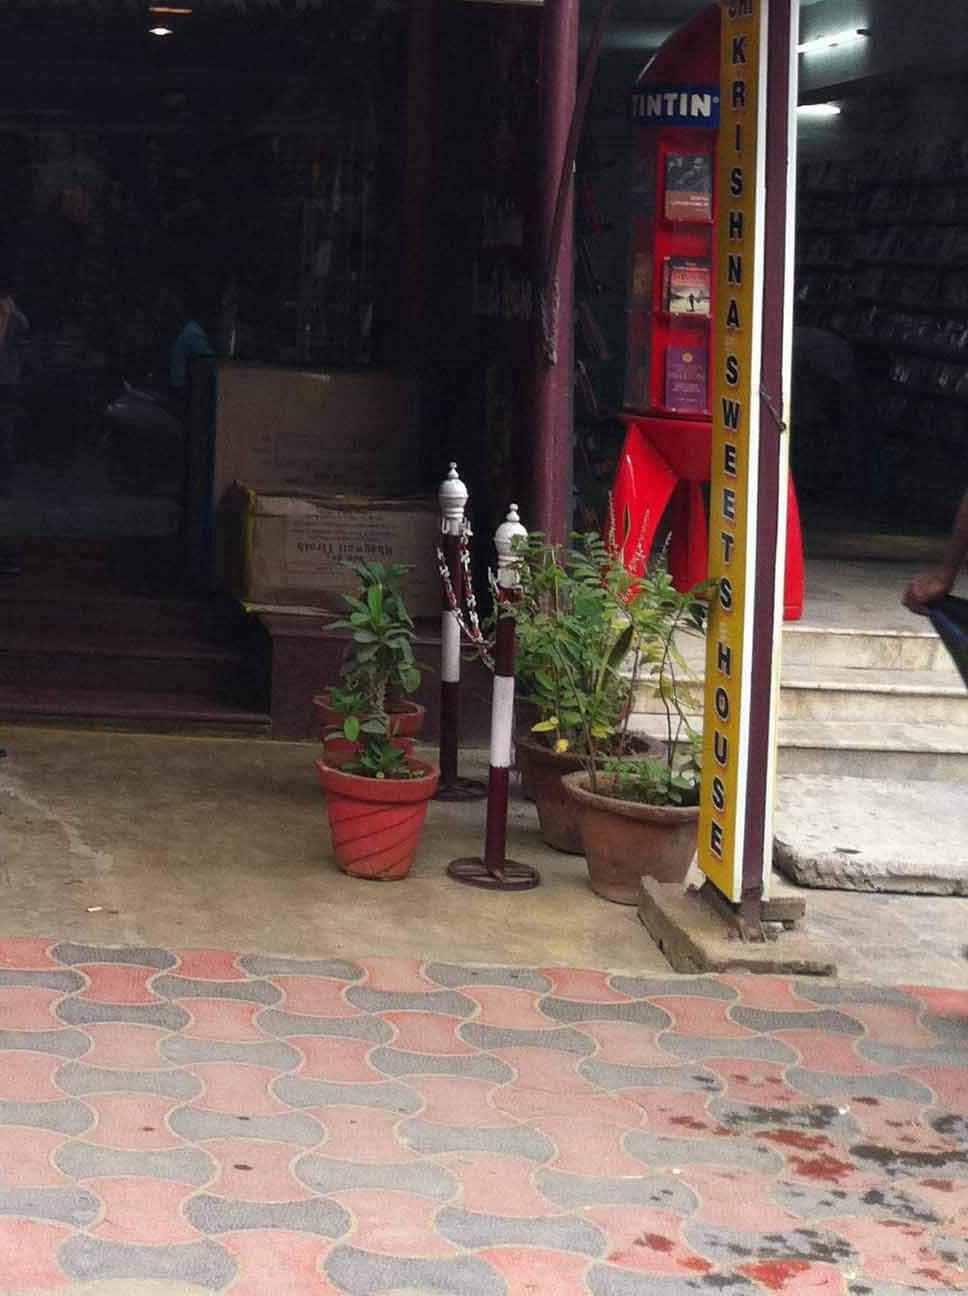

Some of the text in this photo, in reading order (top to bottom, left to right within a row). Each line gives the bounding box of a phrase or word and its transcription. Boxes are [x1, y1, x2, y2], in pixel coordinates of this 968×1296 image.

[726, 35, 749, 329] KRISHNA
[719, 355, 741, 609] SWEETS
[710, 641, 732, 858] HOUSE
